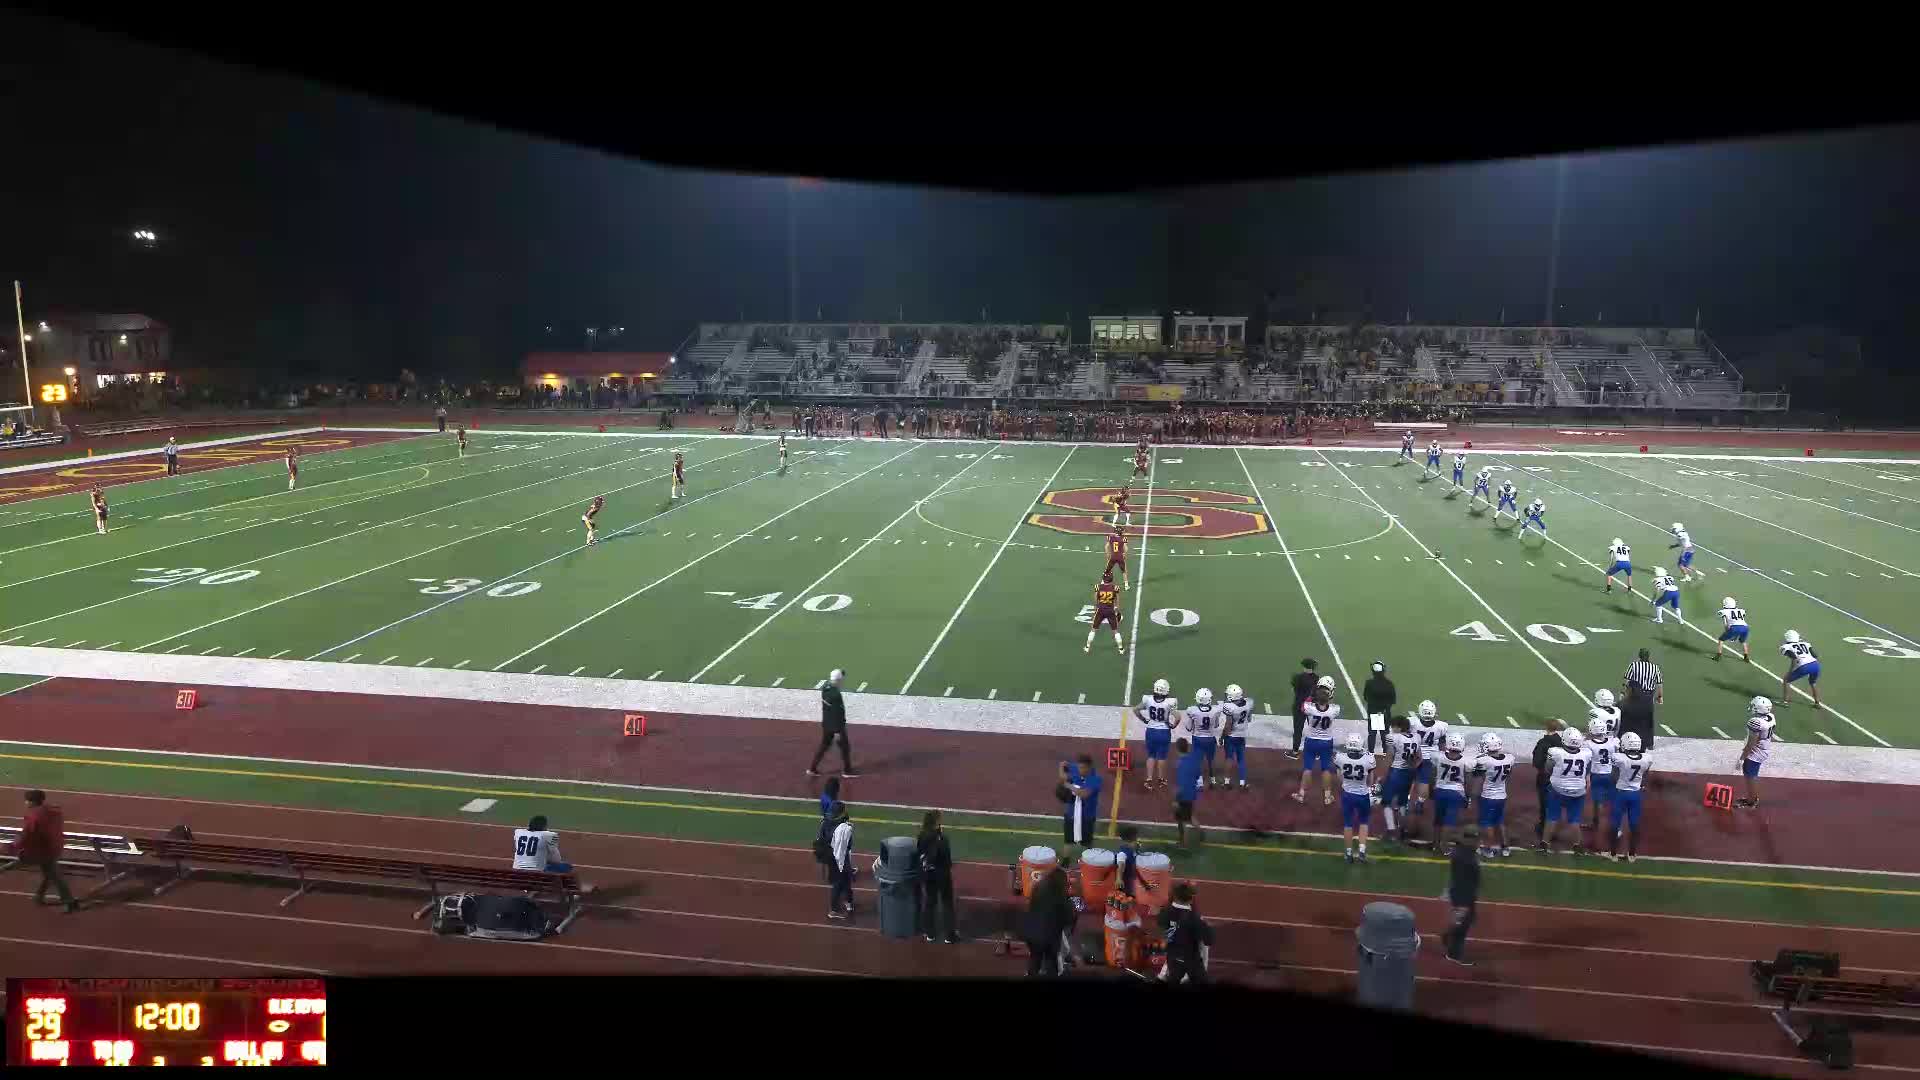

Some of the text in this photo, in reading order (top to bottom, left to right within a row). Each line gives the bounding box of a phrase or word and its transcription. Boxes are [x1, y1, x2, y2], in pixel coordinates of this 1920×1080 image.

[41, 384, 66, 401] 23
[1027, 488, 1269, 539] S
[1616, 546, 1628, 556] 46
[131, 567, 260, 585] 20
[419, 578, 542, 597] 30
[732, 591, 853, 612] 40
[1099, 591, 1114, 604] 22
[1731, 610, 1743, 621] 44
[1450, 620, 1587, 645] 40
[1792, 643, 1808, 656] 30
[177, 691, 193, 707] 30
[1149, 706, 1165, 722] 68
[1312, 715, 1331, 730] 70
[625, 717, 643, 734] 40
[1417, 730, 1435, 746] 74
[1110, 751, 1128, 768] 50
[1599, 749, 1610, 765] 3
[1342, 763, 1364, 781] 23
[1441, 763, 1461, 781] 72
[1489, 764, 1511, 783] 75
[1561, 759, 1585, 777] 73
[1630, 765, 1641, 782] 7
[1706, 786, 1731, 808] 40
[517, 835, 539, 857] 60
